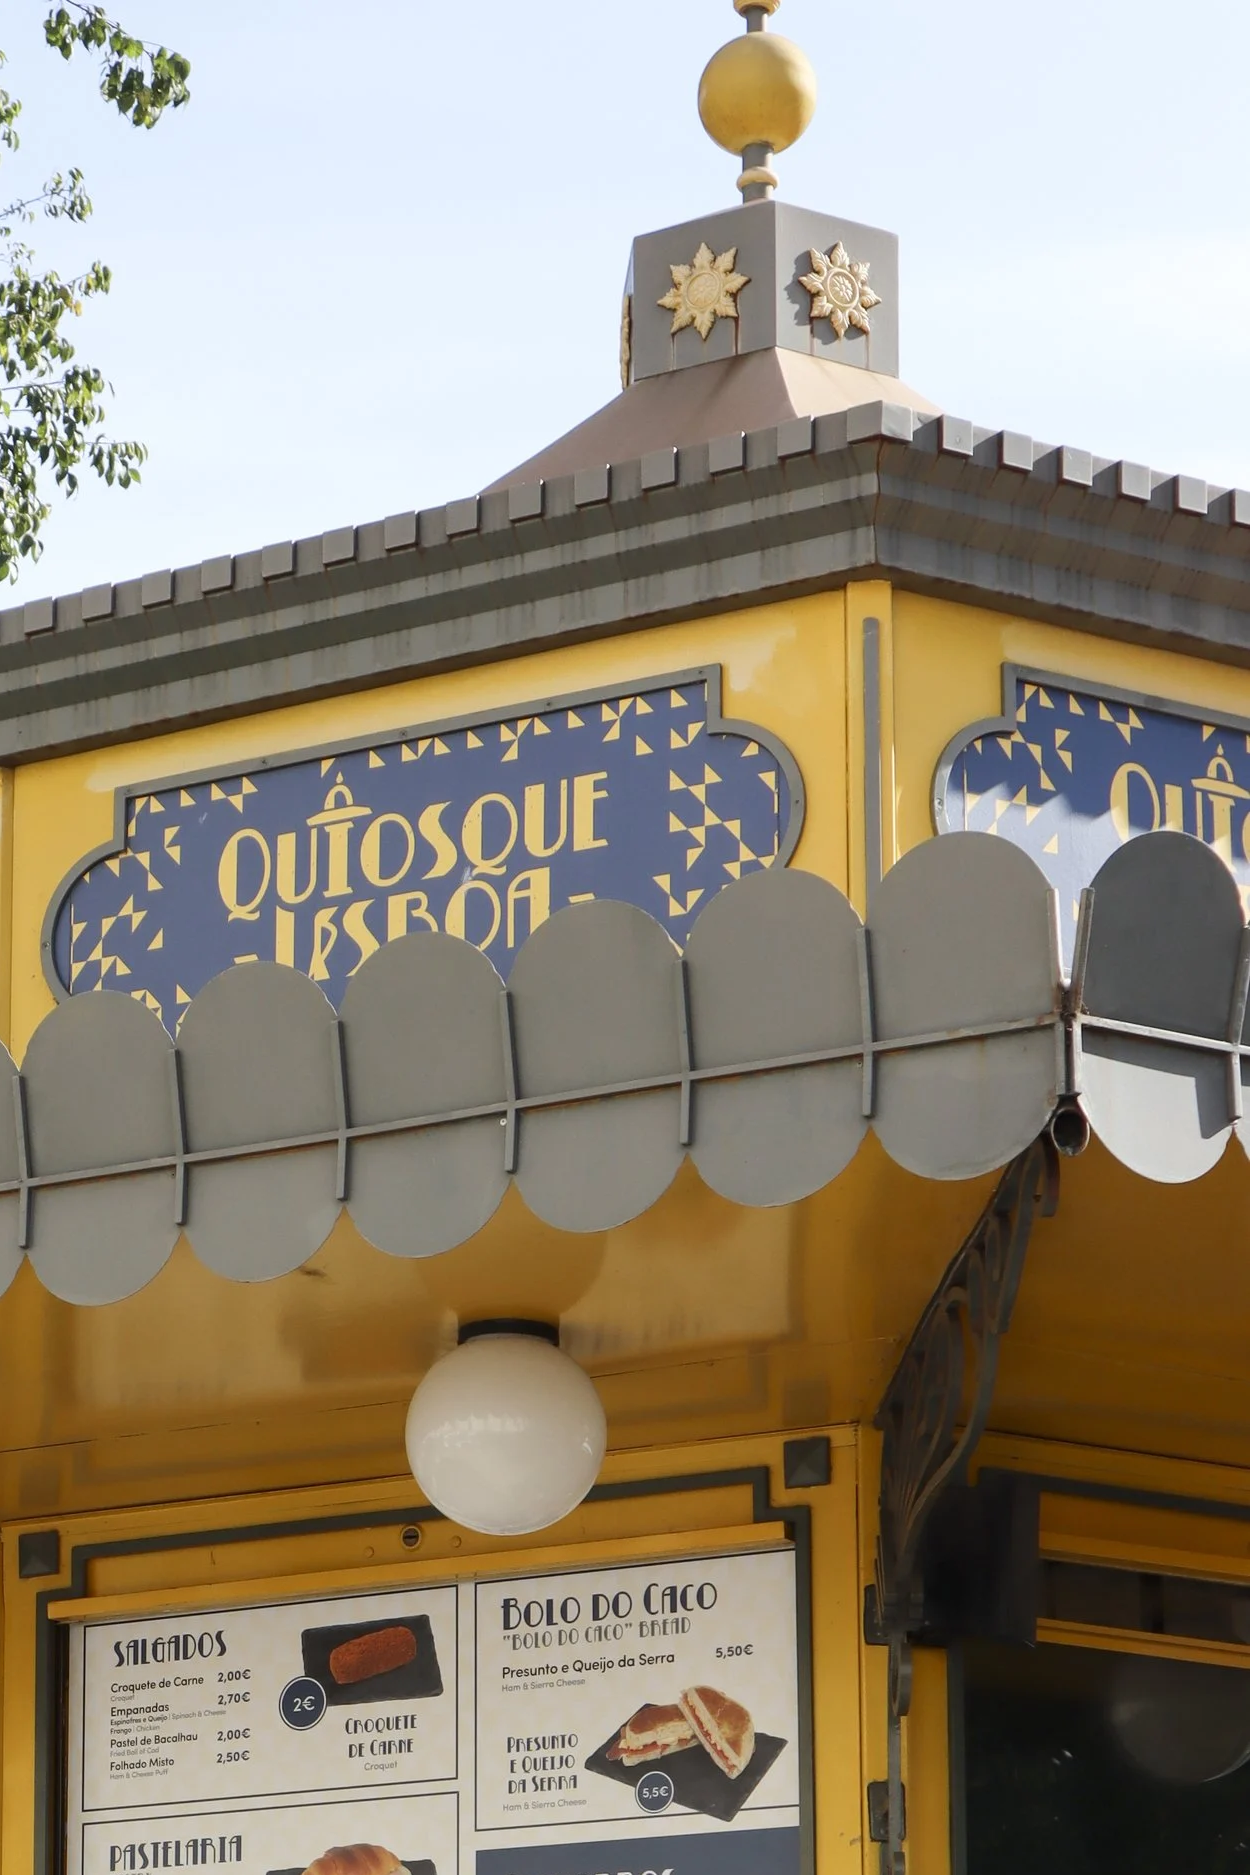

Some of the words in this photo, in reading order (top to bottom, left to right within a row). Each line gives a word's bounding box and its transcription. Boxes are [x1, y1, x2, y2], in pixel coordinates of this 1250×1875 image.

[113, 1630, 227, 1667] SALGADOS
[502, 1664, 558, 1679] Presunto
[562, 1662, 569, 1672] e
[573, 1658, 614, 1673] Queijo
[618, 1655, 635, 1667] da
[638, 1652, 675, 1665] Serra
[715, 1644, 754, 1659] 5,50€
[111, 1678, 156, 1693] Croquete
[159, 1679, 171, 1689] de
[174, 1675, 204, 1687] Carne
[217, 1669, 251, 1683] 2,00€
[501, 1684, 520, 1692] Ham
[531, 1680, 554, 1689] Sierra
[557, 1677, 585, 1687] Cheese
[110, 1702, 170, 1717] Empanadas
[218, 1691, 250, 1705] 2,70€
[293, 1697, 315, 1712] 2€
[345, 1715, 417, 1734] CROQUETE
[110, 1737, 137, 1748] Pastel
[139, 1736, 152, 1745] de
[154, 1733, 198, 1744] Bacalhau
[217, 1728, 250, 1742] 2,00€
[507, 1734, 578, 1753] PRESUNTO
[348, 1744, 364, 1758] DE
[369, 1739, 414, 1756] CARNE
[110, 1760, 147, 1772] Folhado
[149, 1757, 174, 1768] Misto
[216, 1751, 250, 1764] 2,50€
[364, 1761, 398, 1772] Croquet
[510, 1759, 517, 1773] E
[522, 1755, 575, 1773] QUEIJO
[508, 1779, 526, 1794] DA
[532, 1775, 577, 1792] SERRA
[642, 1786, 669, 1798] 5,5€
[502, 1804, 521, 1812] Ham
[532, 1801, 555, 1810] Sierra
[557, 1798, 587, 1807] Cheese
[110, 1835, 243, 1871] PASTELARIA
